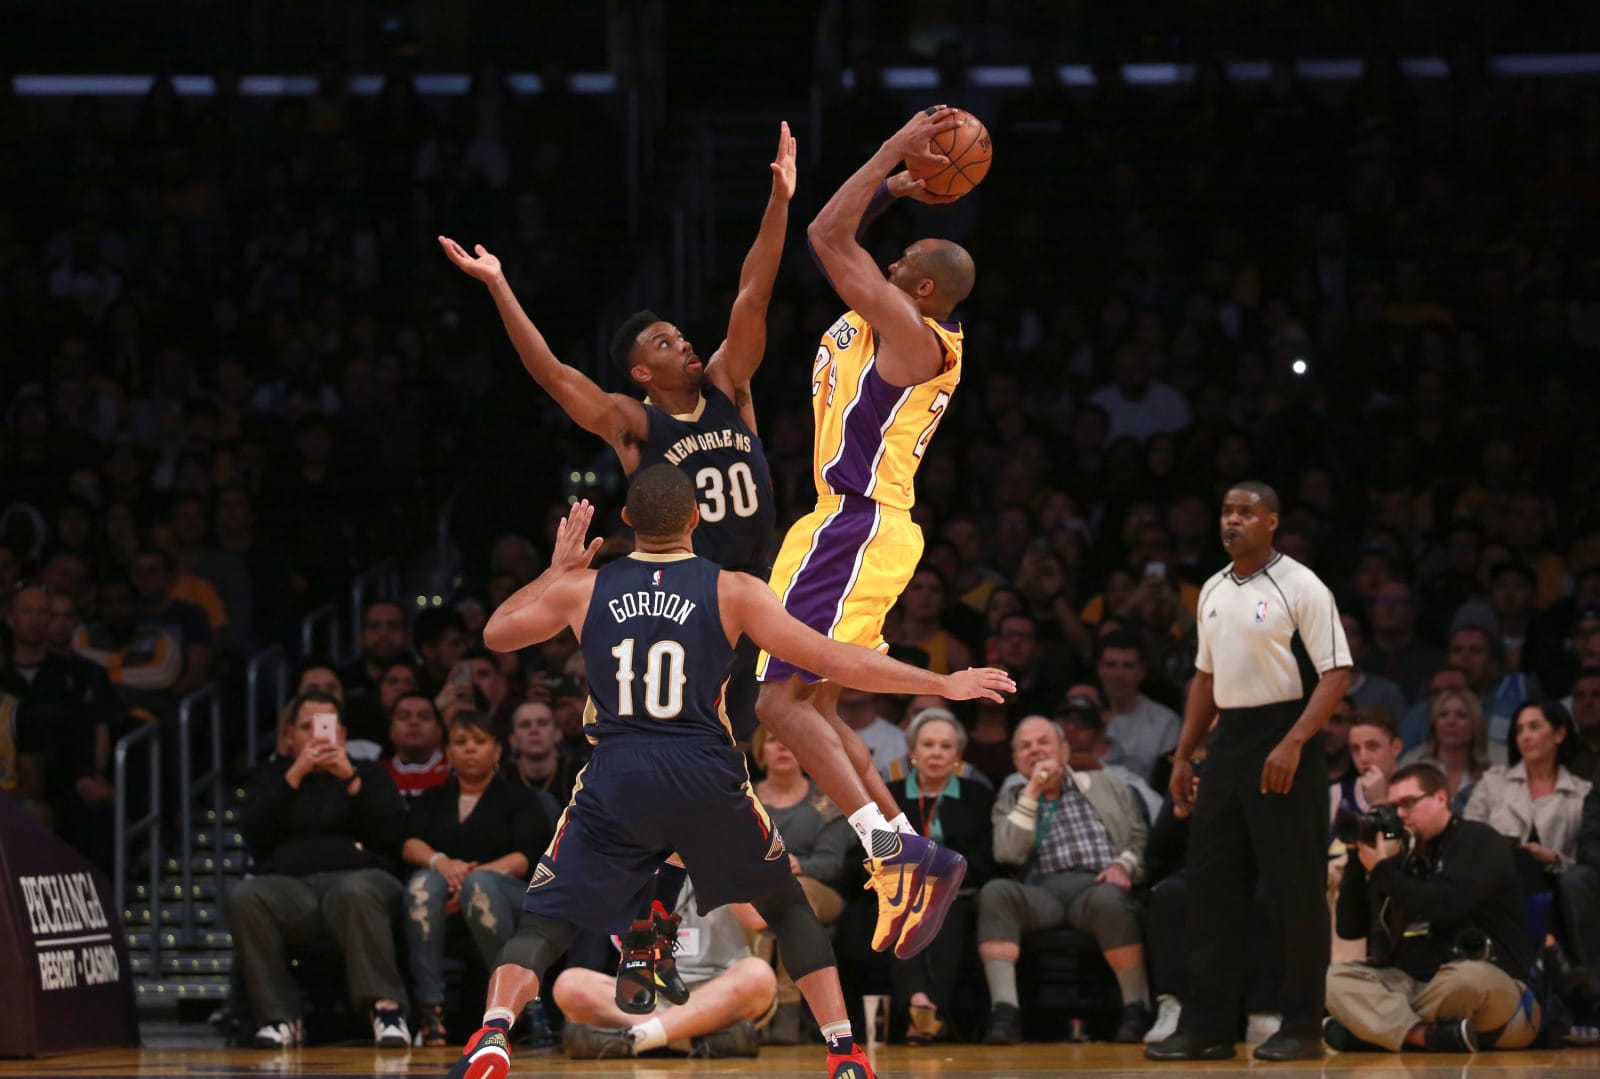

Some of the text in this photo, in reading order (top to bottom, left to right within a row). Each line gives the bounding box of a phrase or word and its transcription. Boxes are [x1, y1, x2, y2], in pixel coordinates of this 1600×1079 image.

[664, 429, 751, 466] NEW ORLENS
[695, 461, 759, 523] 30
[608, 591, 696, 625] GORDON
[611, 638, 687, 719] 10
[19, 872, 108, 934] PECHANGA
[37, 944, 120, 991] RESORT CASINO
